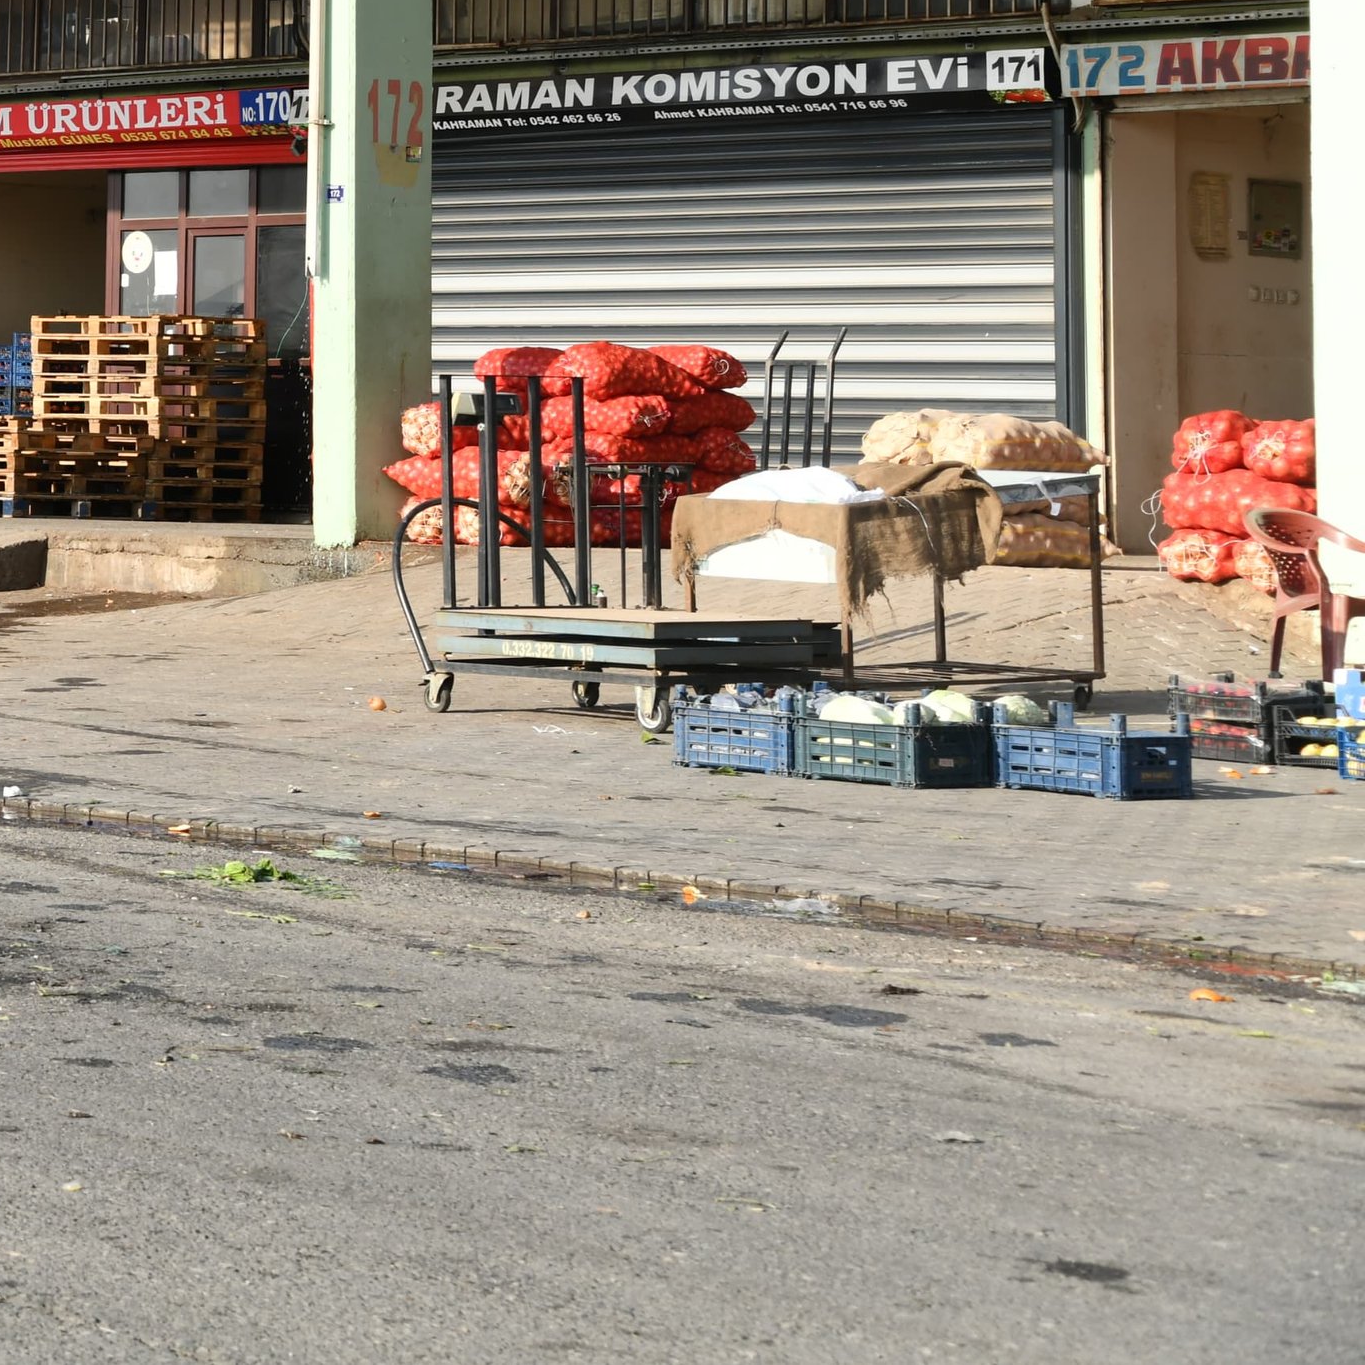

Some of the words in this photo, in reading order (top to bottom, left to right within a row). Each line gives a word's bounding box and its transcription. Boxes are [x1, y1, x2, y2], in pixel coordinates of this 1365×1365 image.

[991, 54, 1041, 84] 171
[1066, 45, 1146, 88] 172
[435, 77, 595, 114] RAMAN
[367, 79, 423, 147] 172
[433, 118, 503, 131] KAHRAMAN
[504, 117, 527, 127] Tel:
[530, 116, 560, 126] 0542
[562, 114, 585, 124] 462
[586, 113, 603, 123] 66
[605, 112, 621, 122] 26
[654, 109, 695, 120] Ahmet
[696, 105, 774, 118] KAHRAMAN
[775, 104, 802, 114] Tel:
[804, 101, 837, 113] 0541
[840, 100, 867, 111] 716
[869, 99, 887, 110] 66
[889, 98, 908, 109] 96
[0, 136, 58, 149] Mustafa
[121, 131, 156, 143] 0535
[159, 129, 189, 140] 674
[192, 128, 210, 139] 84
[215, 127, 233, 138] 45
[561, 645, 574, 660] 70
